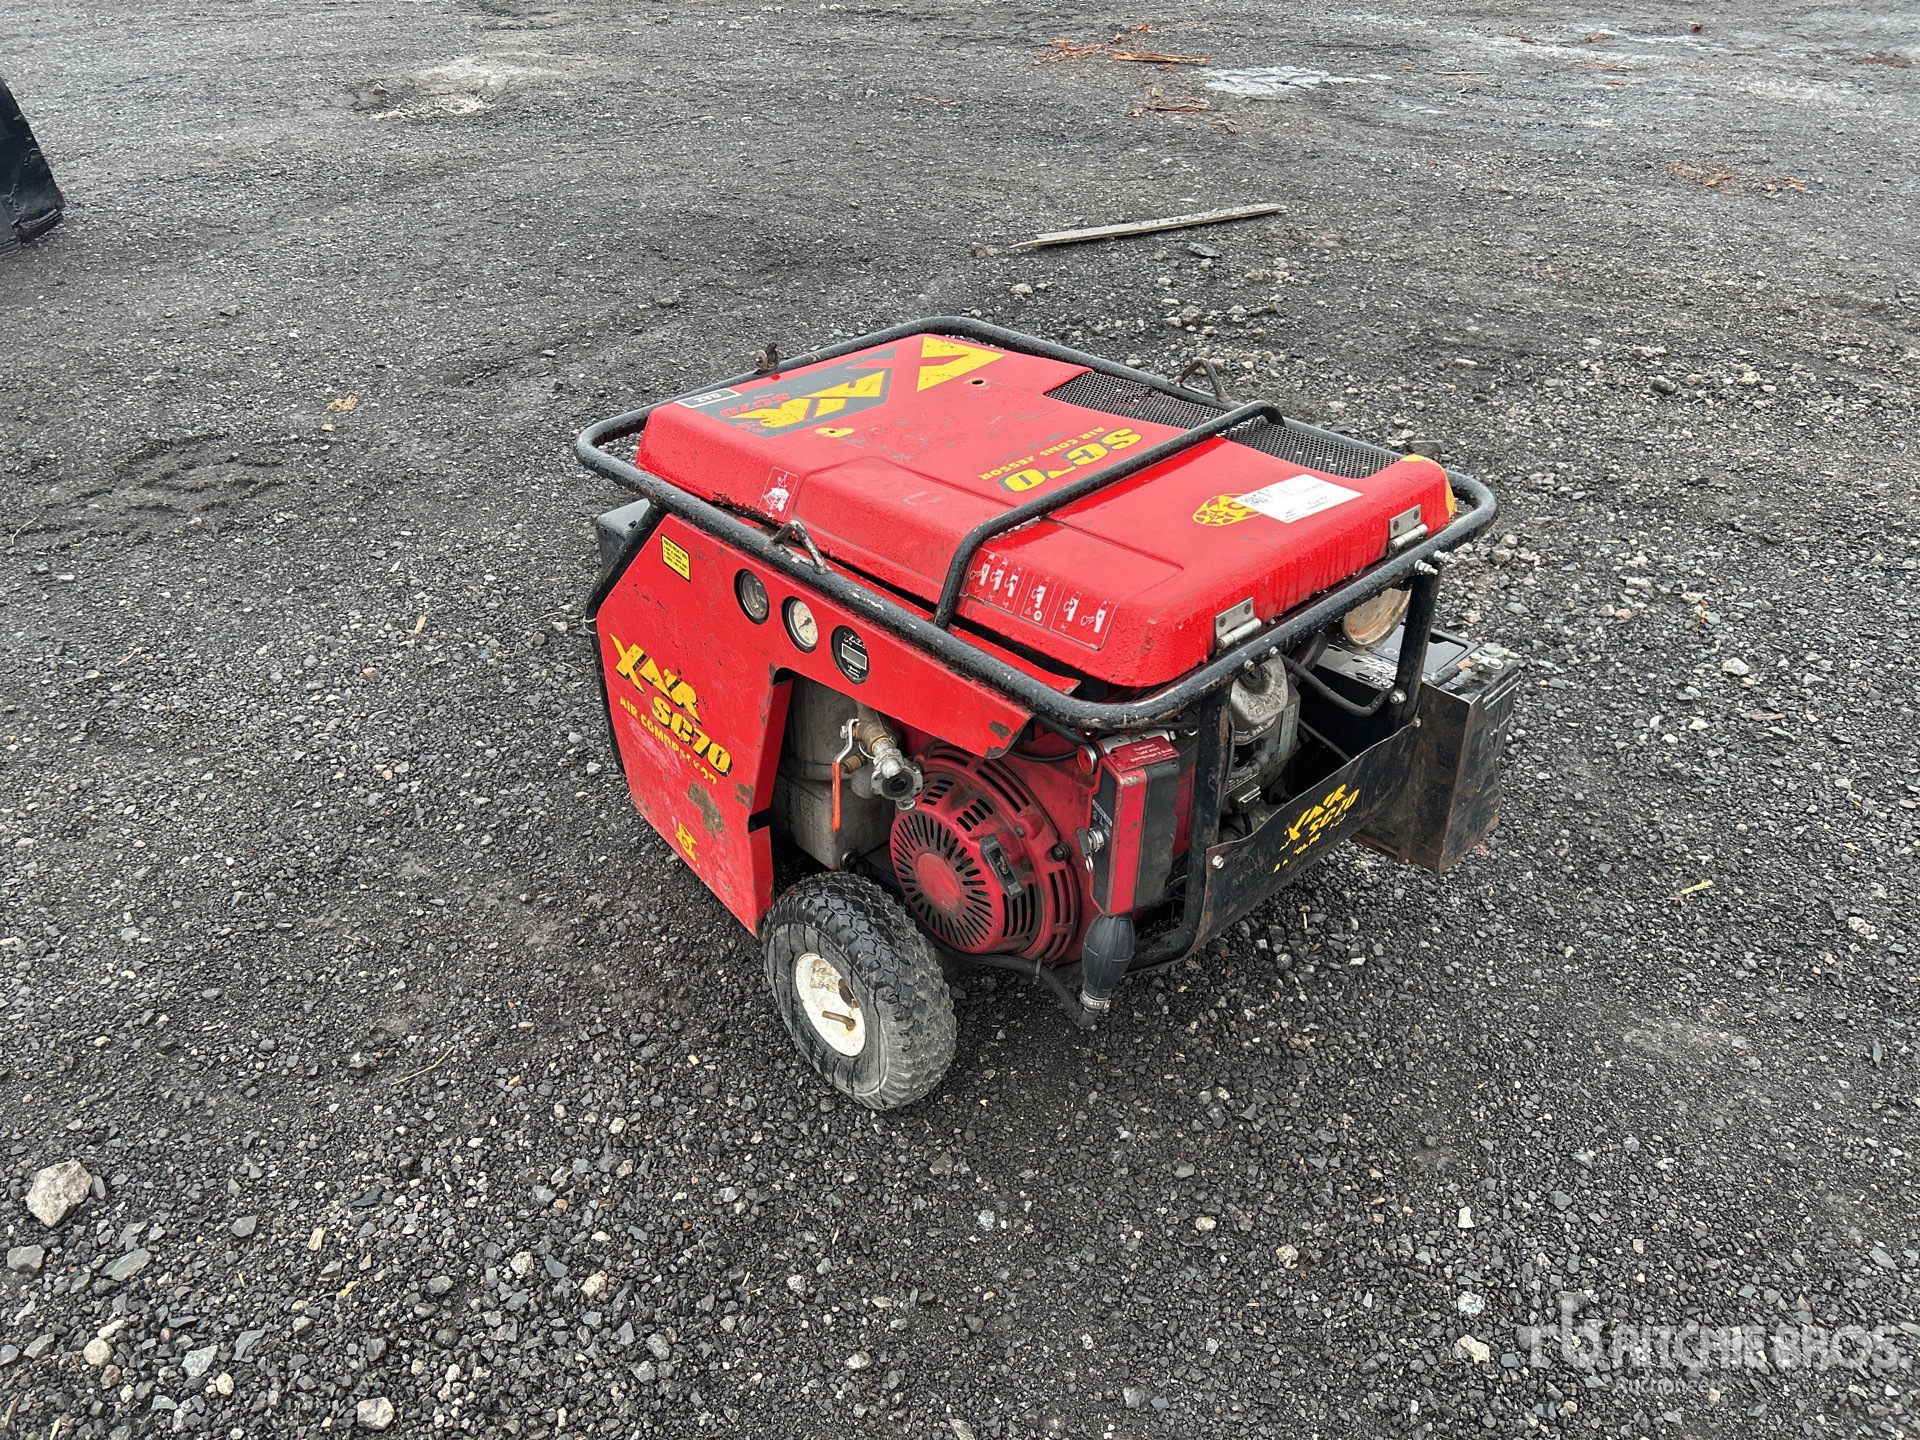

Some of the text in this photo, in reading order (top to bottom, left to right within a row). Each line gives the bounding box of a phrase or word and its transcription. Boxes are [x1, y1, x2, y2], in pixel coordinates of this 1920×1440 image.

[1078, 426, 1105, 441] AIR
[609, 633, 702, 723] XAIR
[620, 697, 640, 720] AIR
[652, 695, 733, 778] SC70
